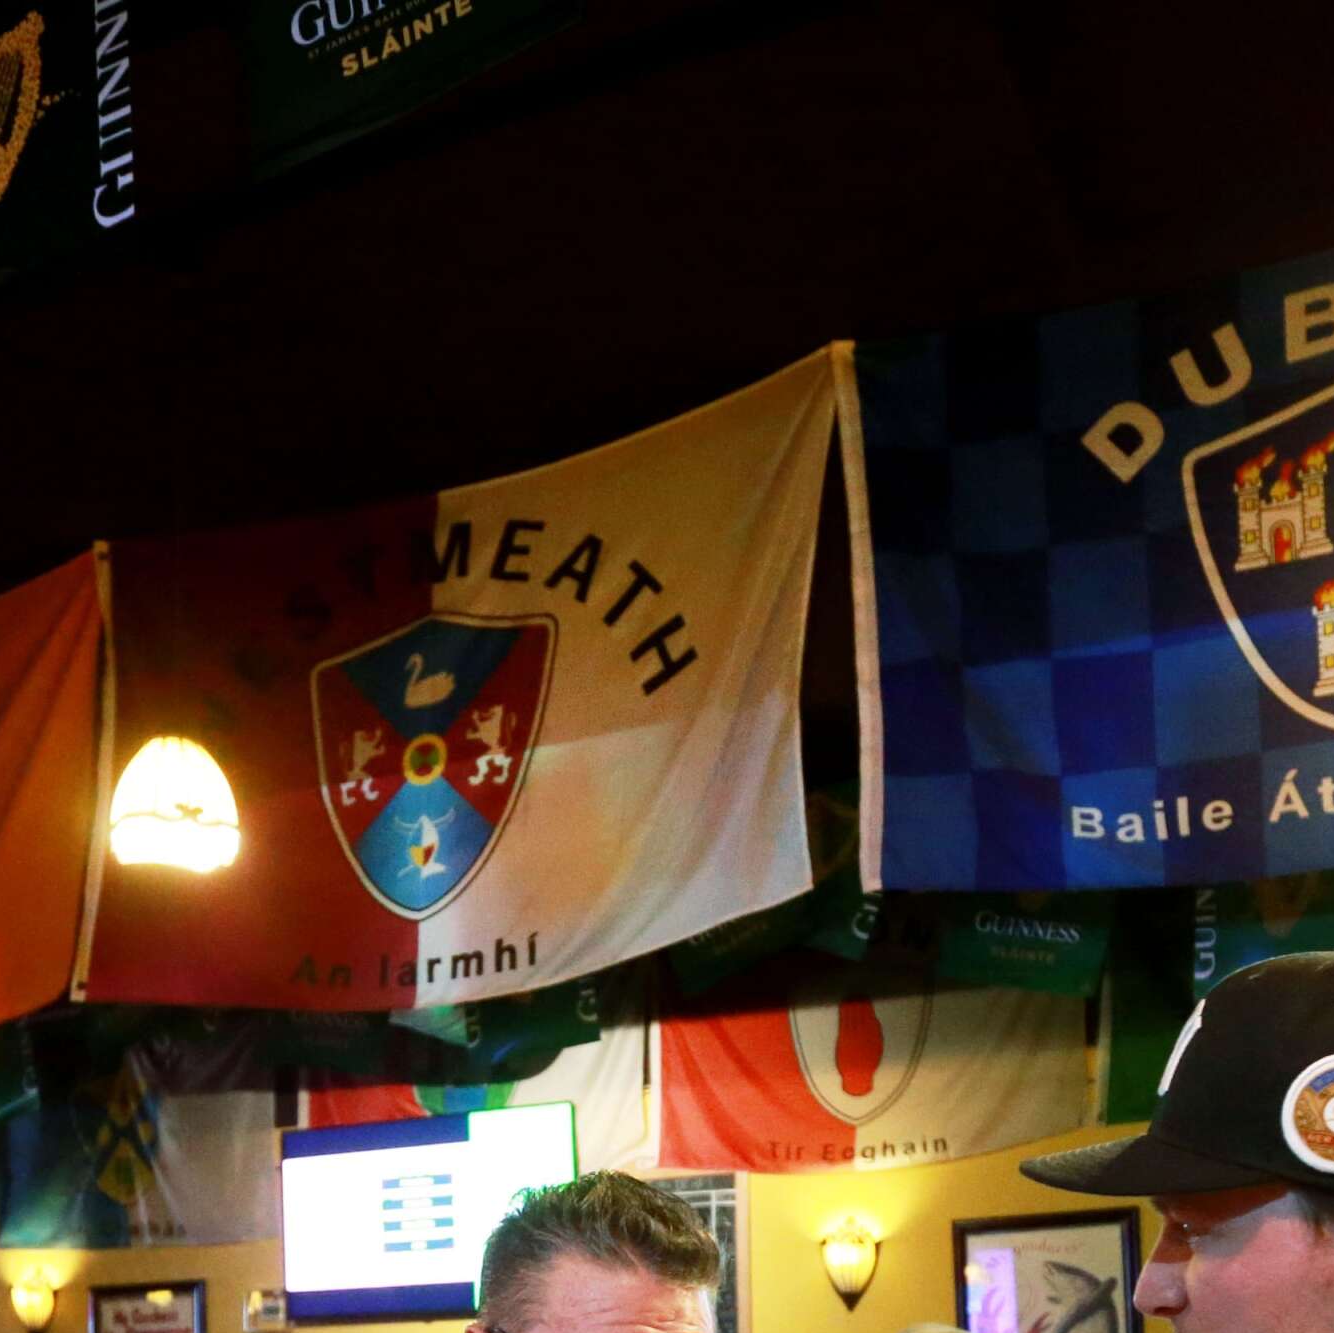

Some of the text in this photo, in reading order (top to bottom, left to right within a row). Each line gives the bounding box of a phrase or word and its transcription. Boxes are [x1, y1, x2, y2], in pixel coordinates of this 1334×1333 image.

[340, 0, 474, 78] SLÁINTE
[1070, 795, 1235, 844] Baile
[974, 909, 1082, 945] GUINNESS
[378, 930, 540, 988] Iarmhí
